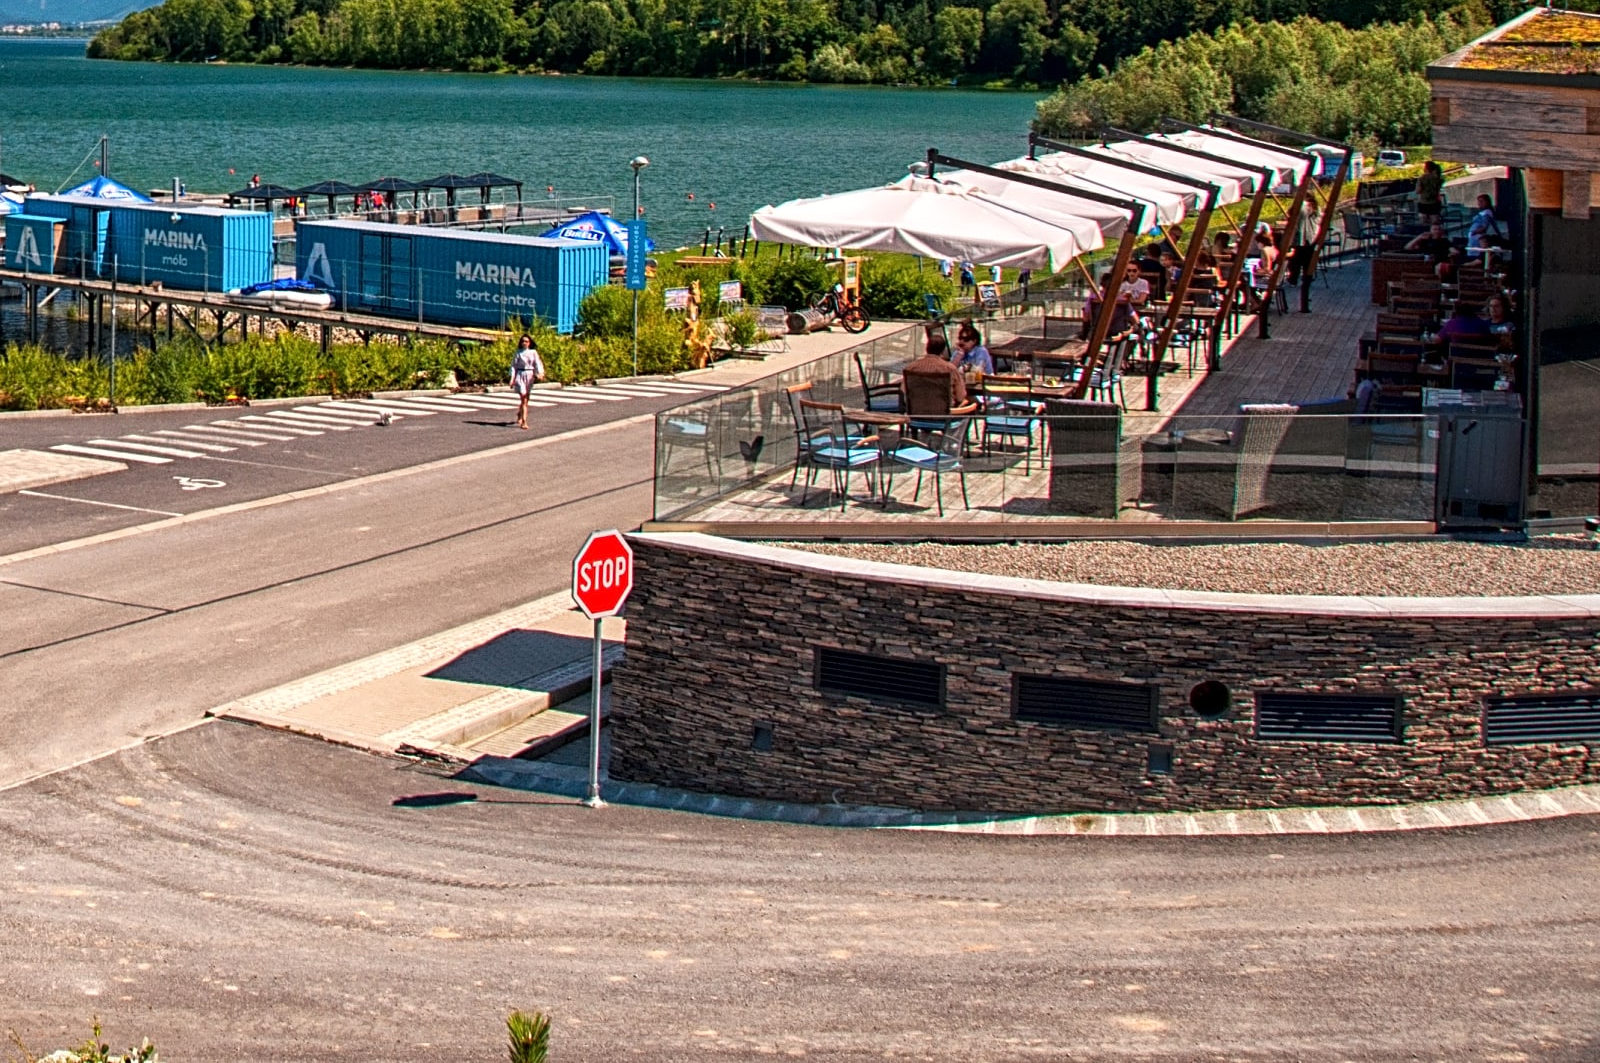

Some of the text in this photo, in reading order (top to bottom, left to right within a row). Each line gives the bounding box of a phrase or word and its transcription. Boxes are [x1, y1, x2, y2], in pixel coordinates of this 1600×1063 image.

[144, 228, 207, 252] MARINA
[455, 260, 537, 289] MARINA
[455, 289, 536, 308] sport centre
[580, 556, 627, 592] STOP
